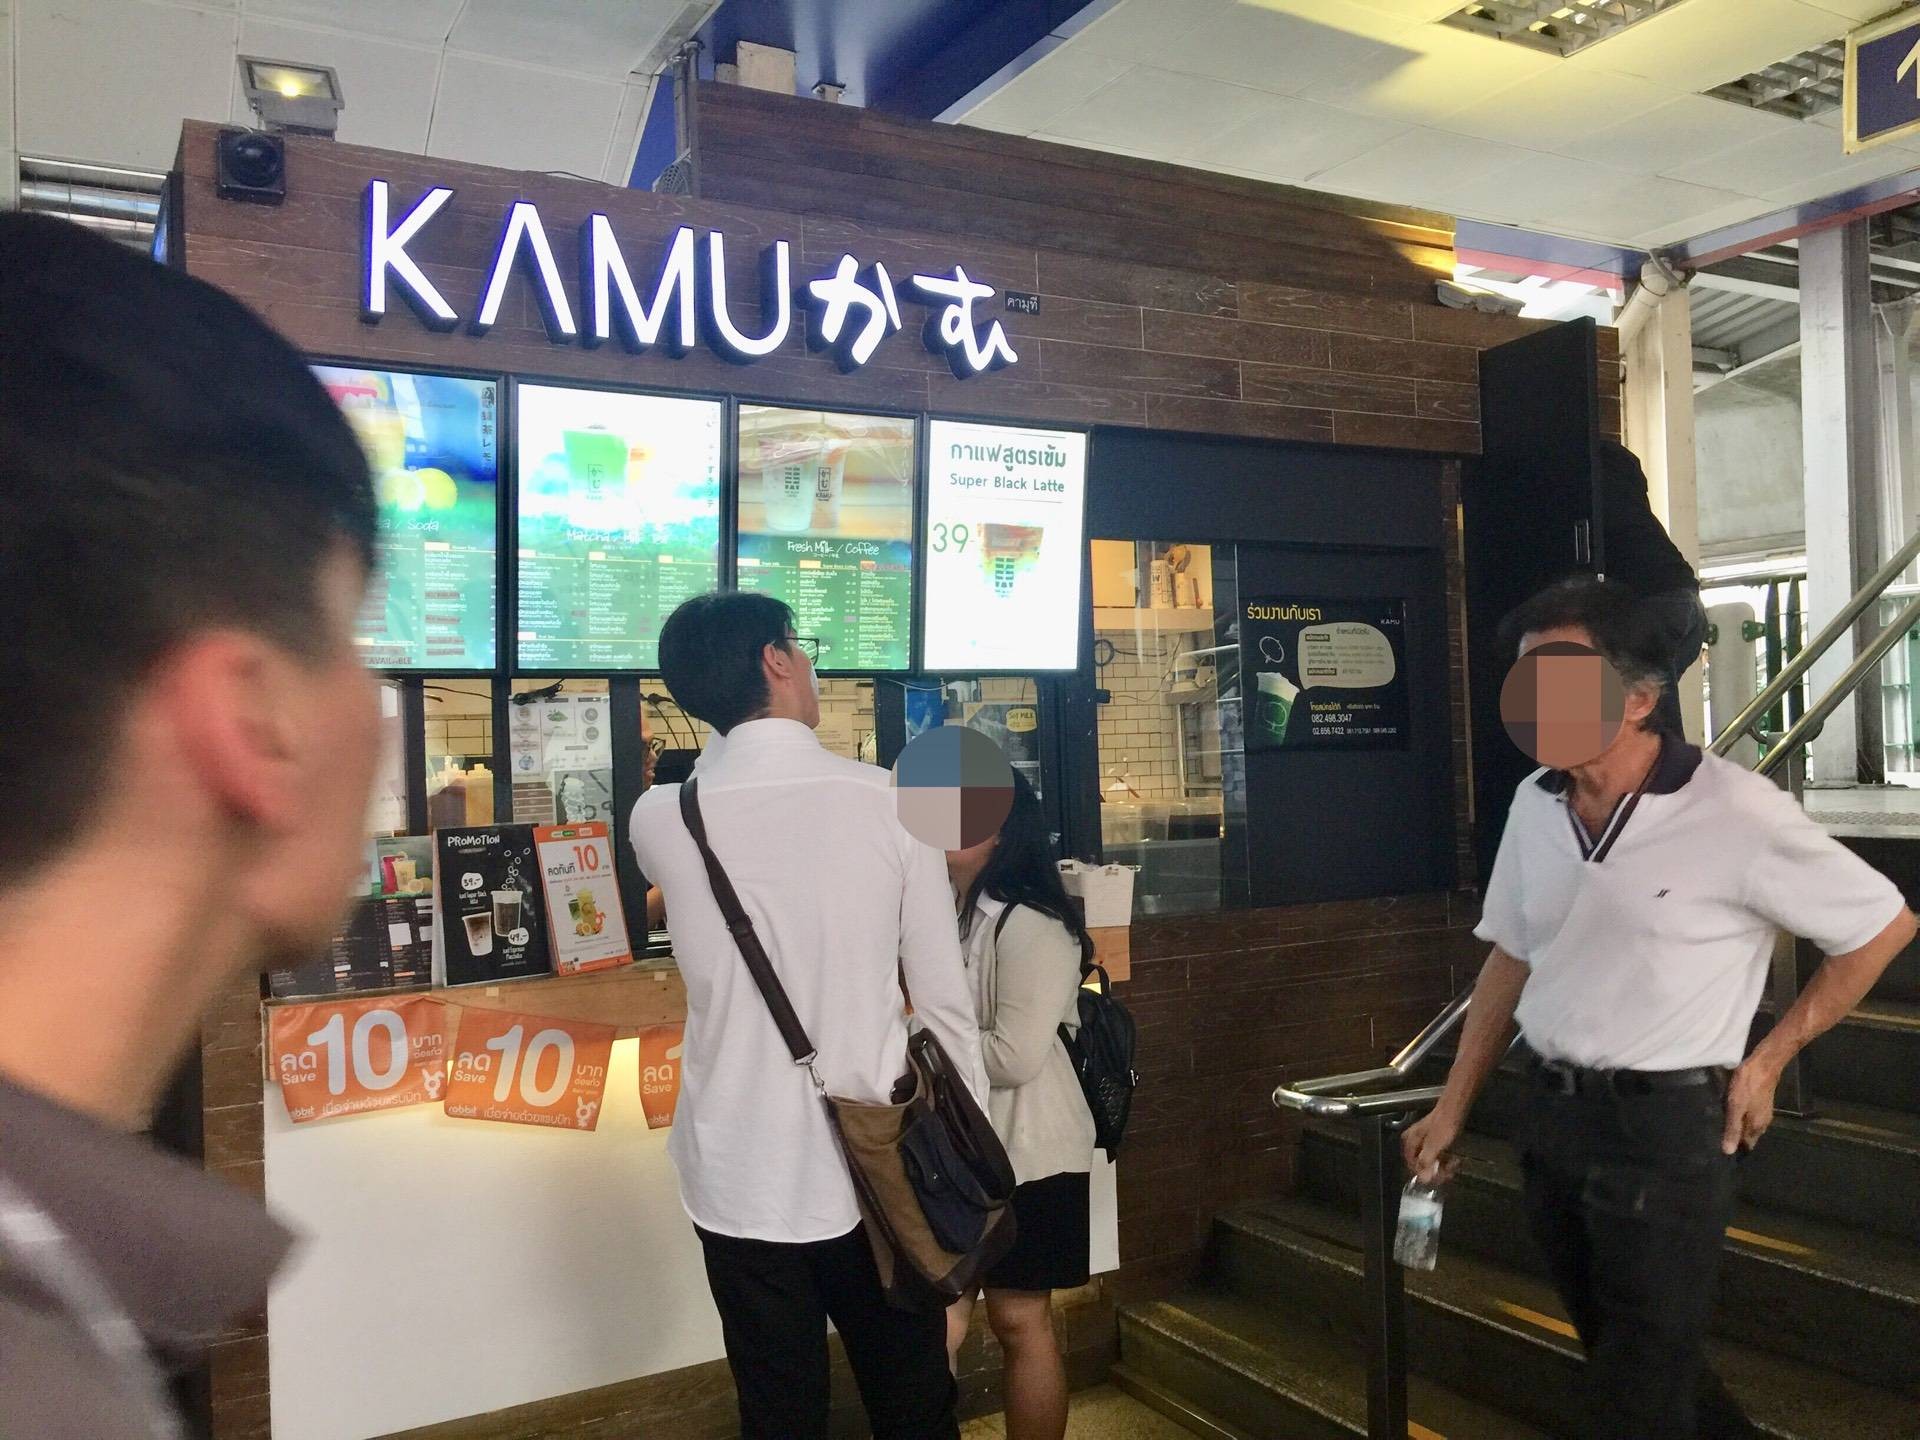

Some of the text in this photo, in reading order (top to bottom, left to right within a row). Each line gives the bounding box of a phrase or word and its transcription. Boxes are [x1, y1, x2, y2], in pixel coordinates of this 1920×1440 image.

[368, 180, 790, 357] KAMU
[950, 443, 1067, 471] กาแฟสูตรเข้ม
[950, 473, 1065, 493] Super Black Latte
[407, 519, 440, 531] Soda
[787, 541, 813, 553] Fresh
[814, 541, 836, 554] Milk
[845, 542, 880, 556] Coffee
[1247, 602, 1322, 621] ร่วมงานกับเรา
[547, 863, 576, 876] ลดทันที
[573, 844, 599, 872] 10
[280, 1009, 443, 1097] ลด 10 บาท
[457, 1024, 604, 1107] ลด 10 บาท
[642, 1063, 674, 1083] ลด
[281, 1072, 316, 1086] Save
[453, 1069, 487, 1084] Save
[642, 1083, 673, 1095] Save
[448, 1103, 478, 1115] rabbit
